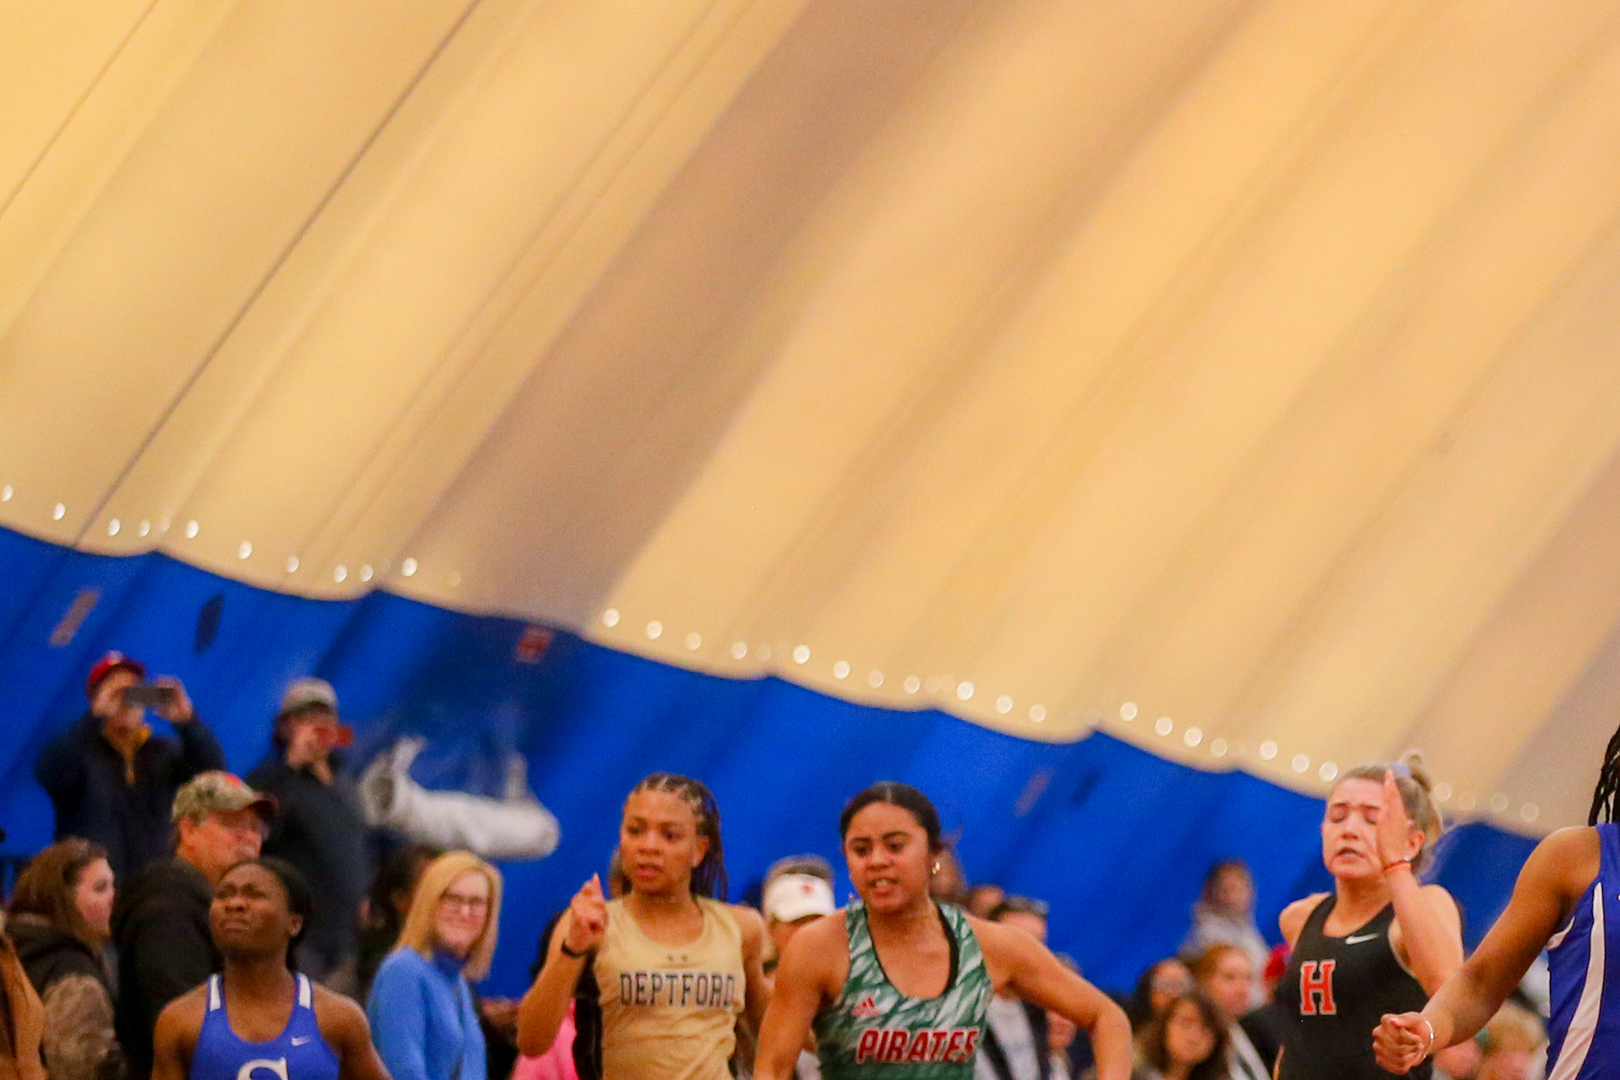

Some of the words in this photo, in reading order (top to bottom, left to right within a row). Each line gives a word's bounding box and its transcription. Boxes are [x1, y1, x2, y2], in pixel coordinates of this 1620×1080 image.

[620, 973, 735, 1006] DEPTFORD
[1300, 959, 1336, 1015] H
[856, 1027, 979, 1063] PIRATES
